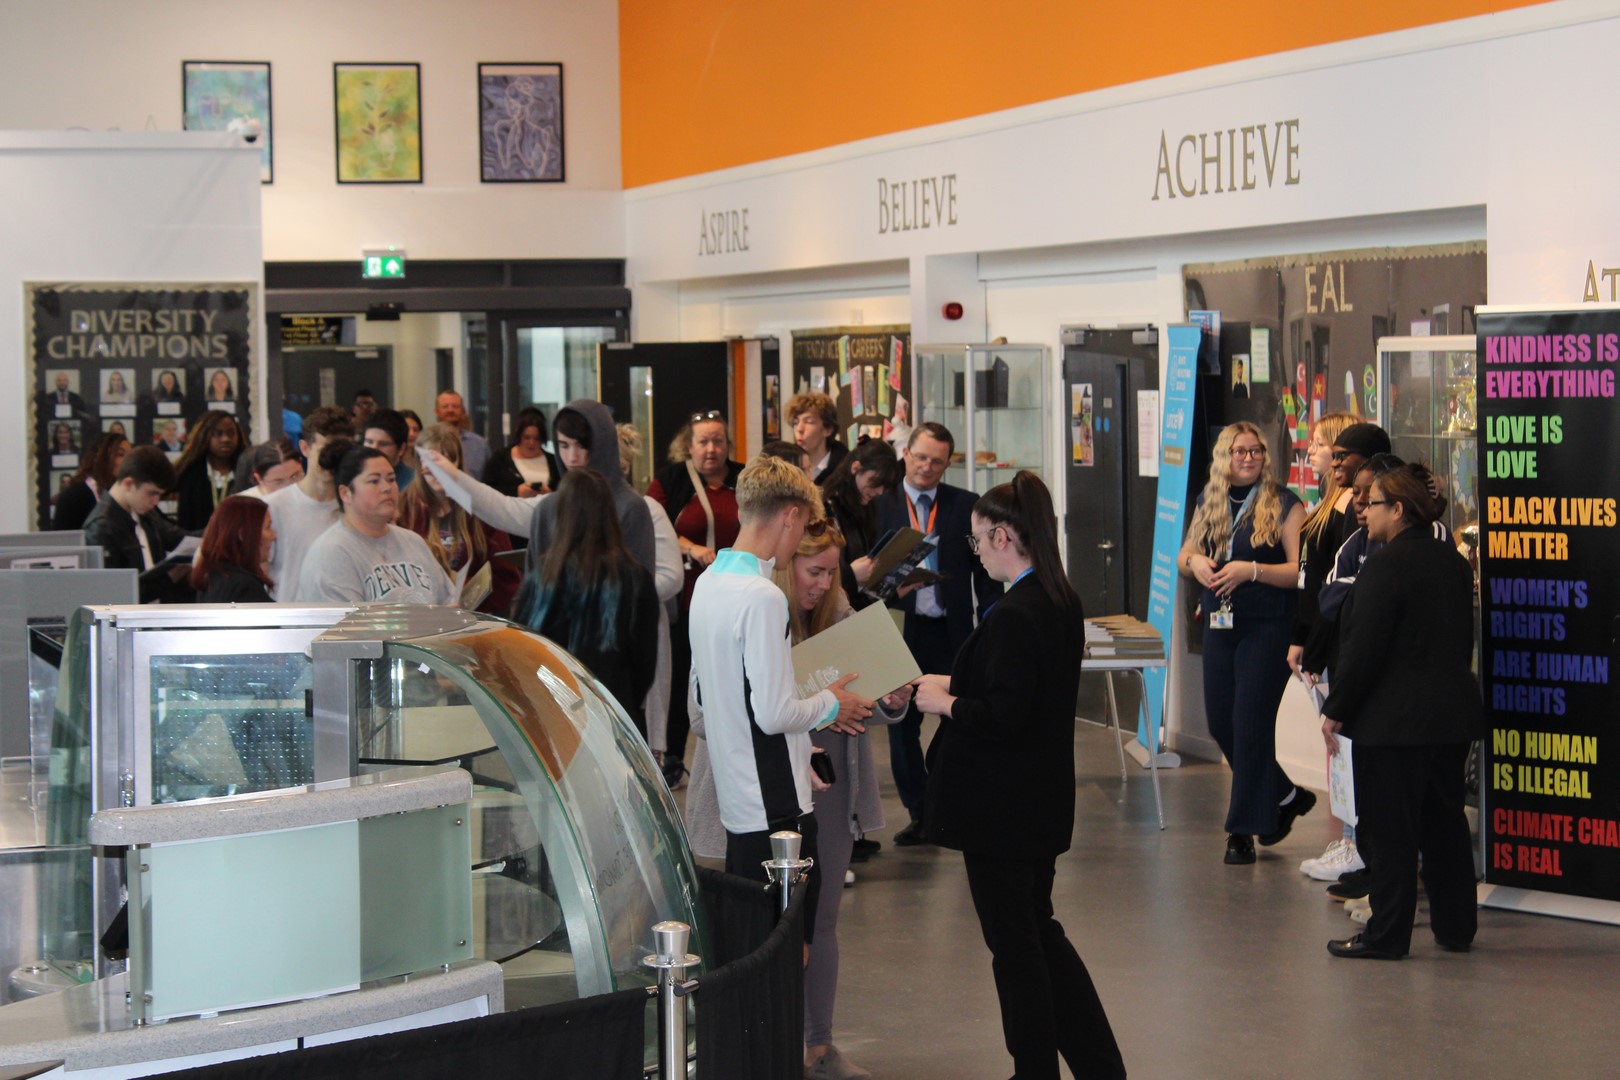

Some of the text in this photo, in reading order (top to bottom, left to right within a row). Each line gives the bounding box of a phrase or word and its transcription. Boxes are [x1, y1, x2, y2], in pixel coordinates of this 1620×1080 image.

[1151, 118, 1300, 201] ACHIEVE
[877, 173, 958, 234] BELIEVE
[698, 208, 750, 256] ASPIRE
[1304, 263, 1353, 313] EAL
[70, 309, 217, 333] DIVERSITY
[47, 333, 228, 360] CHAMPIONS
[1486, 333, 1619, 363] KINDNESS IS
[1486, 370, 1615, 398] EVERYTHING
[1486, 415, 1563, 444] LOVE IS
[1487, 450, 1537, 478] LOVE
[1487, 496, 1617, 527] BLACK LIVES
[1488, 531, 1569, 560] MATTER
[1489, 577, 1588, 608] WOMEN'S
[1490, 611, 1566, 641] RIGHTS
[1492, 650, 1609, 684] ARE HUMAN
[1492, 684, 1566, 715] RIGHTS
[1493, 728, 1598, 764] NO HUMAN
[1493, 763, 1592, 799] IS ILLEGAL
[1493, 808, 1620, 849] CLIMATE CHA
[1493, 843, 1563, 876] IS REAL
